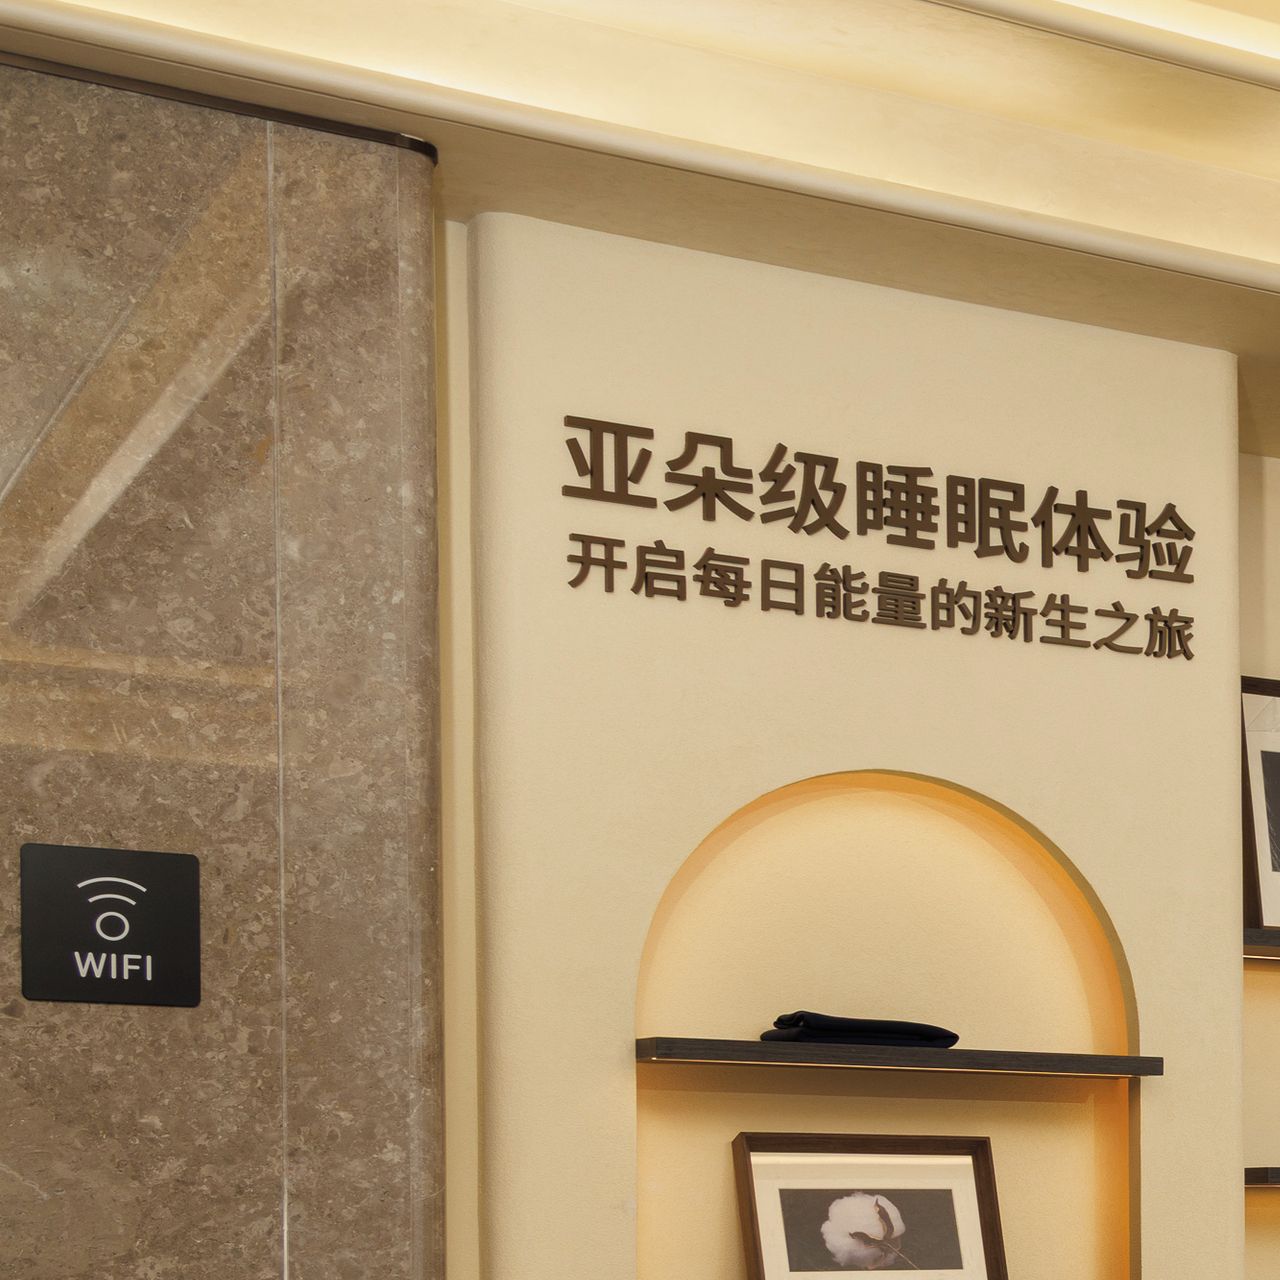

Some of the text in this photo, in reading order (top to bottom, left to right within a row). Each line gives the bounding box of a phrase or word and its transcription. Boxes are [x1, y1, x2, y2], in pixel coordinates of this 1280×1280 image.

[562, 415, 1195, 584] 亚朵级睡眠体验
[567, 533, 1194, 661] 开启每日能量的新生之旅
[74, 951, 152, 981] WIFI
